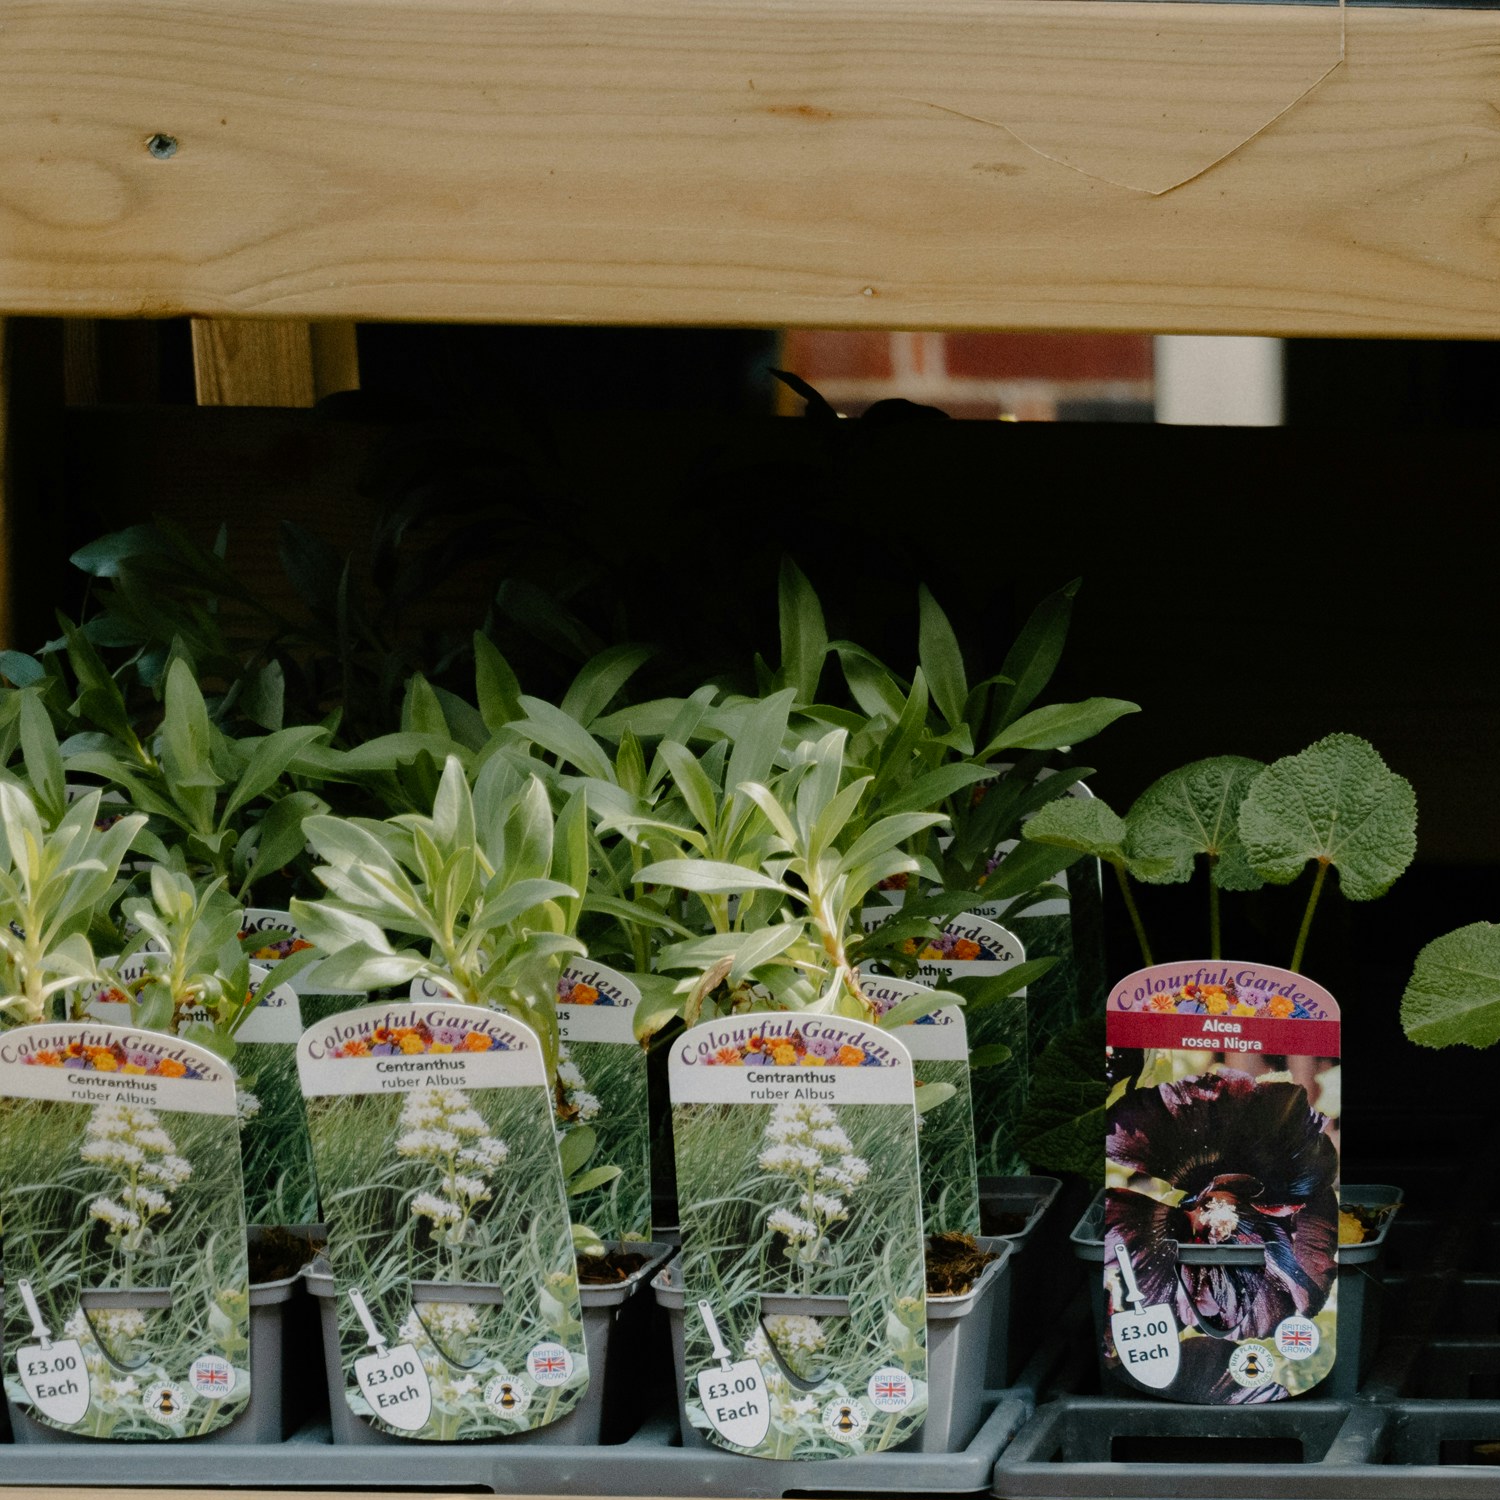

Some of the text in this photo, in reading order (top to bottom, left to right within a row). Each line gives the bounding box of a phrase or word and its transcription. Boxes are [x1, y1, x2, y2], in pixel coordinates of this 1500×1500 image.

[1116, 968, 1328, 1020] Colourful Gardens
[308, 1009, 529, 1060] Colourful Gardens
[1202, 1019, 1241, 1033] Alcea
[681, 1019, 901, 1067] Colourful Gardens
[1181, 1036, 1262, 1053] rosea Nigra
[376, 1059, 466, 1074] Centranthus
[382, 1069, 467, 1088] ruber Albus
[747, 1071, 837, 1084] Centranthus
[750, 1085, 836, 1100] ruber Albus
[1120, 1320, 1168, 1342] £3.00
[1281, 1323, 1313, 1332] BRITISH
[1128, 1343, 1169, 1364] Each
[1280, 1345, 1312, 1354] GROWN
[367, 1361, 415, 1387] £3.00
[377, 1385, 420, 1409] Each
